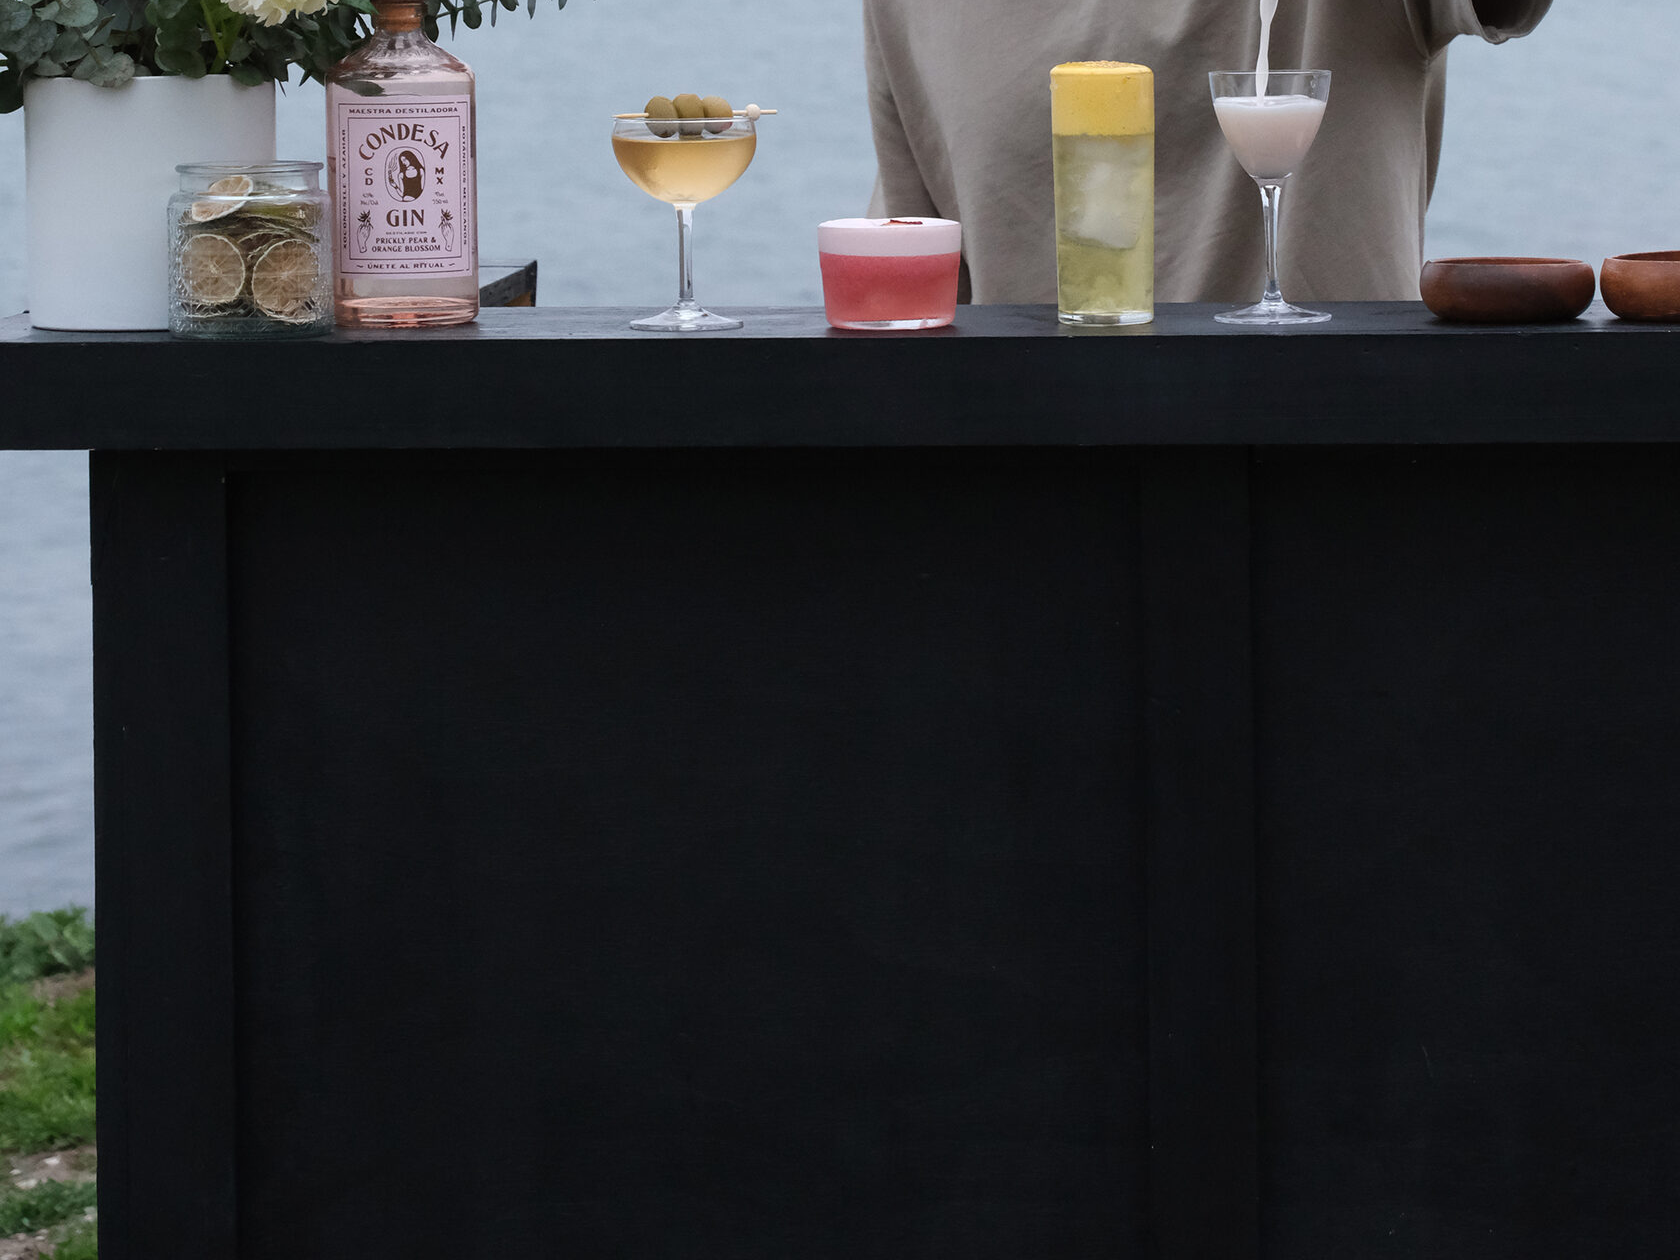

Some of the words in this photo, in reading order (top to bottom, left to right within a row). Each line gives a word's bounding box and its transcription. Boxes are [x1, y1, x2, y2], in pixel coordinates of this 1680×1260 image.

[358, 123, 450, 160] CONDESA
[386, 209, 425, 228] GIN
[408, 236, 428, 244] PEAR
[371, 245, 402, 253] ORANGE
[405, 244, 441, 252] BLOSSOM
